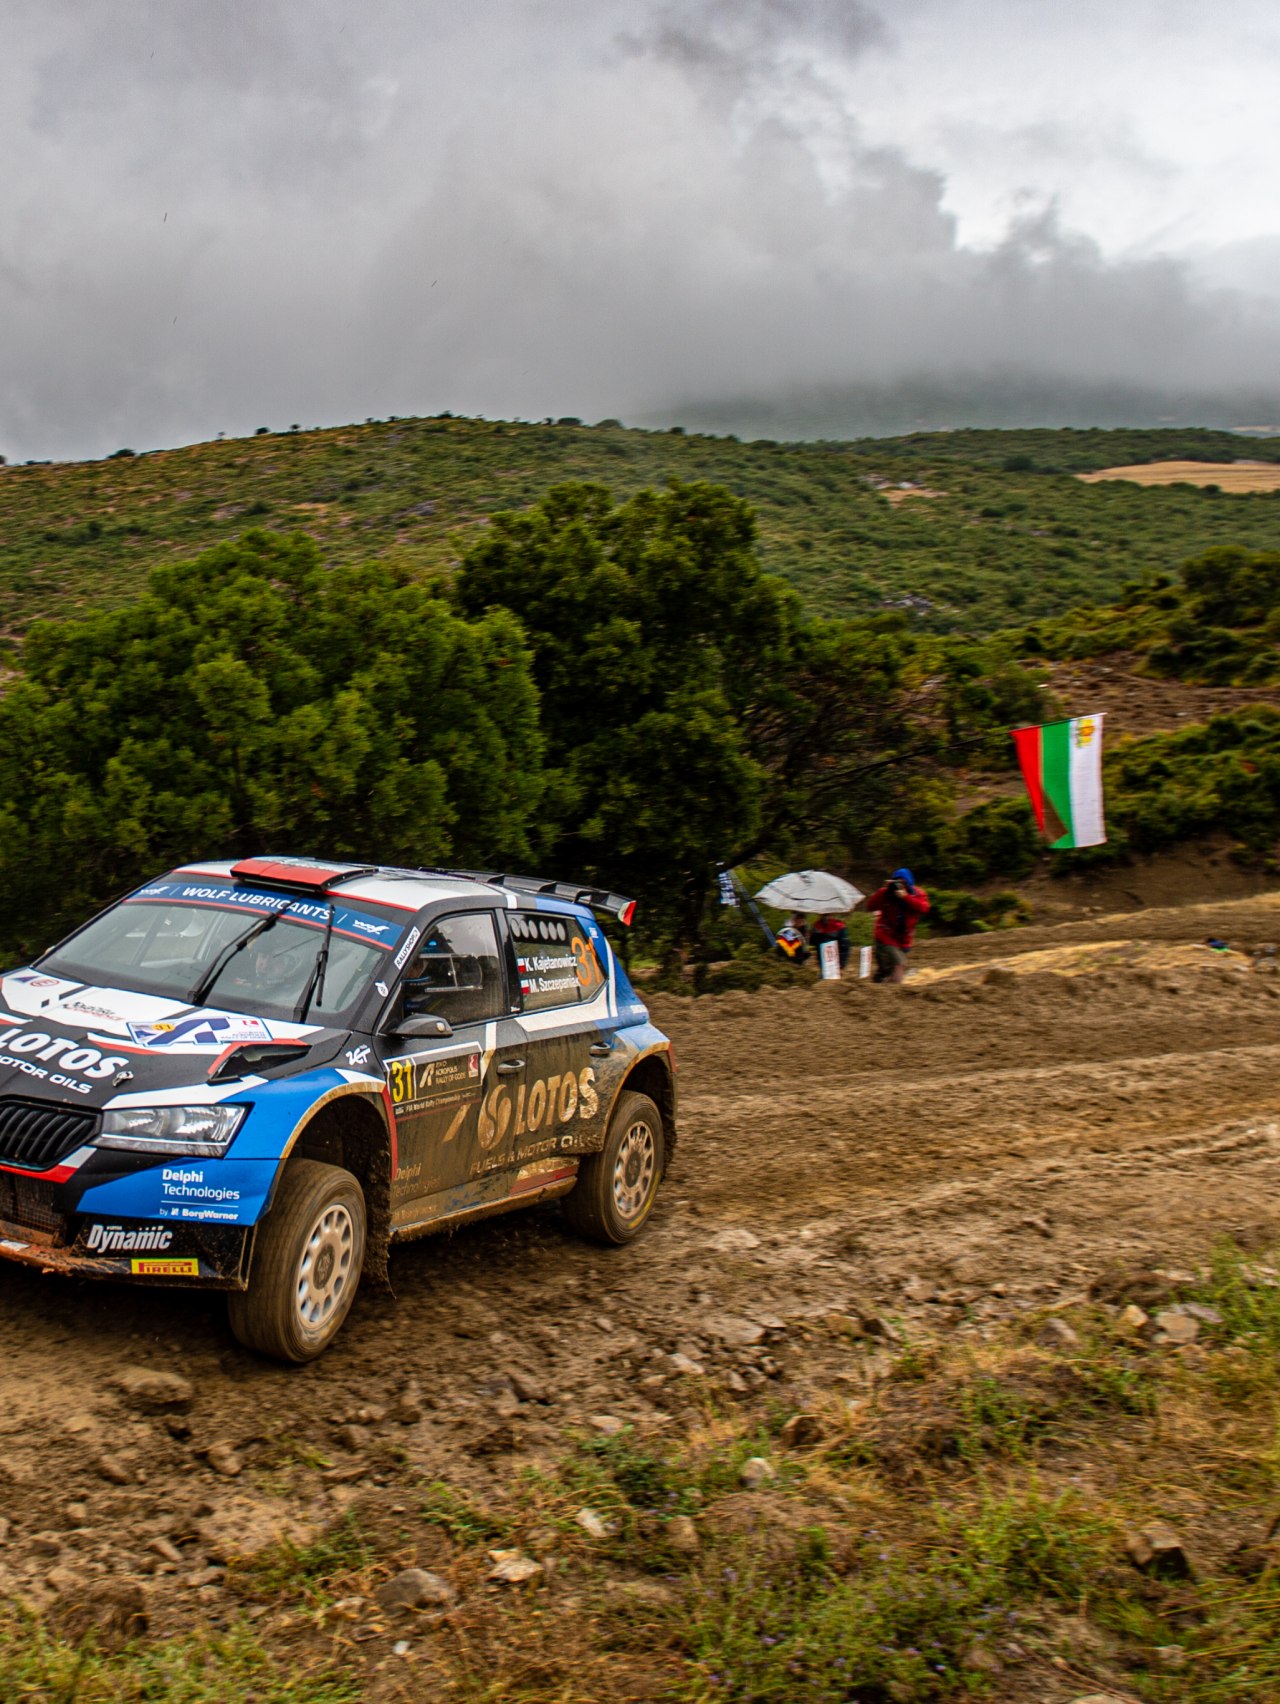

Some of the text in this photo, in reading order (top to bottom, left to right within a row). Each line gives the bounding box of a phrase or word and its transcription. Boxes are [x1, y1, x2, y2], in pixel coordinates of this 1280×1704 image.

[182, 886, 335, 920] WOLF LUBRICANTS
[524, 954, 578, 973] K. Kajetanowicz
[571, 936, 601, 987] 31
[529, 975, 581, 994] M. Szczepaniak
[49, 1074, 93, 1094] OILS
[392, 1059, 413, 1103] 31
[513, 1067, 599, 1136] LOTOS
[469, 1152, 506, 1174] FUELS
[517, 1137, 558, 1160] MOTOR
[162, 1169, 204, 1184] Delphi
[396, 1162, 422, 1181] Delphi
[162, 1183, 240, 1201] Technologies
[159, 1208, 239, 1221] by BorgWarner
[87, 1224, 173, 1253] Dynamic
[138, 1262, 193, 1273] PIRELLI
